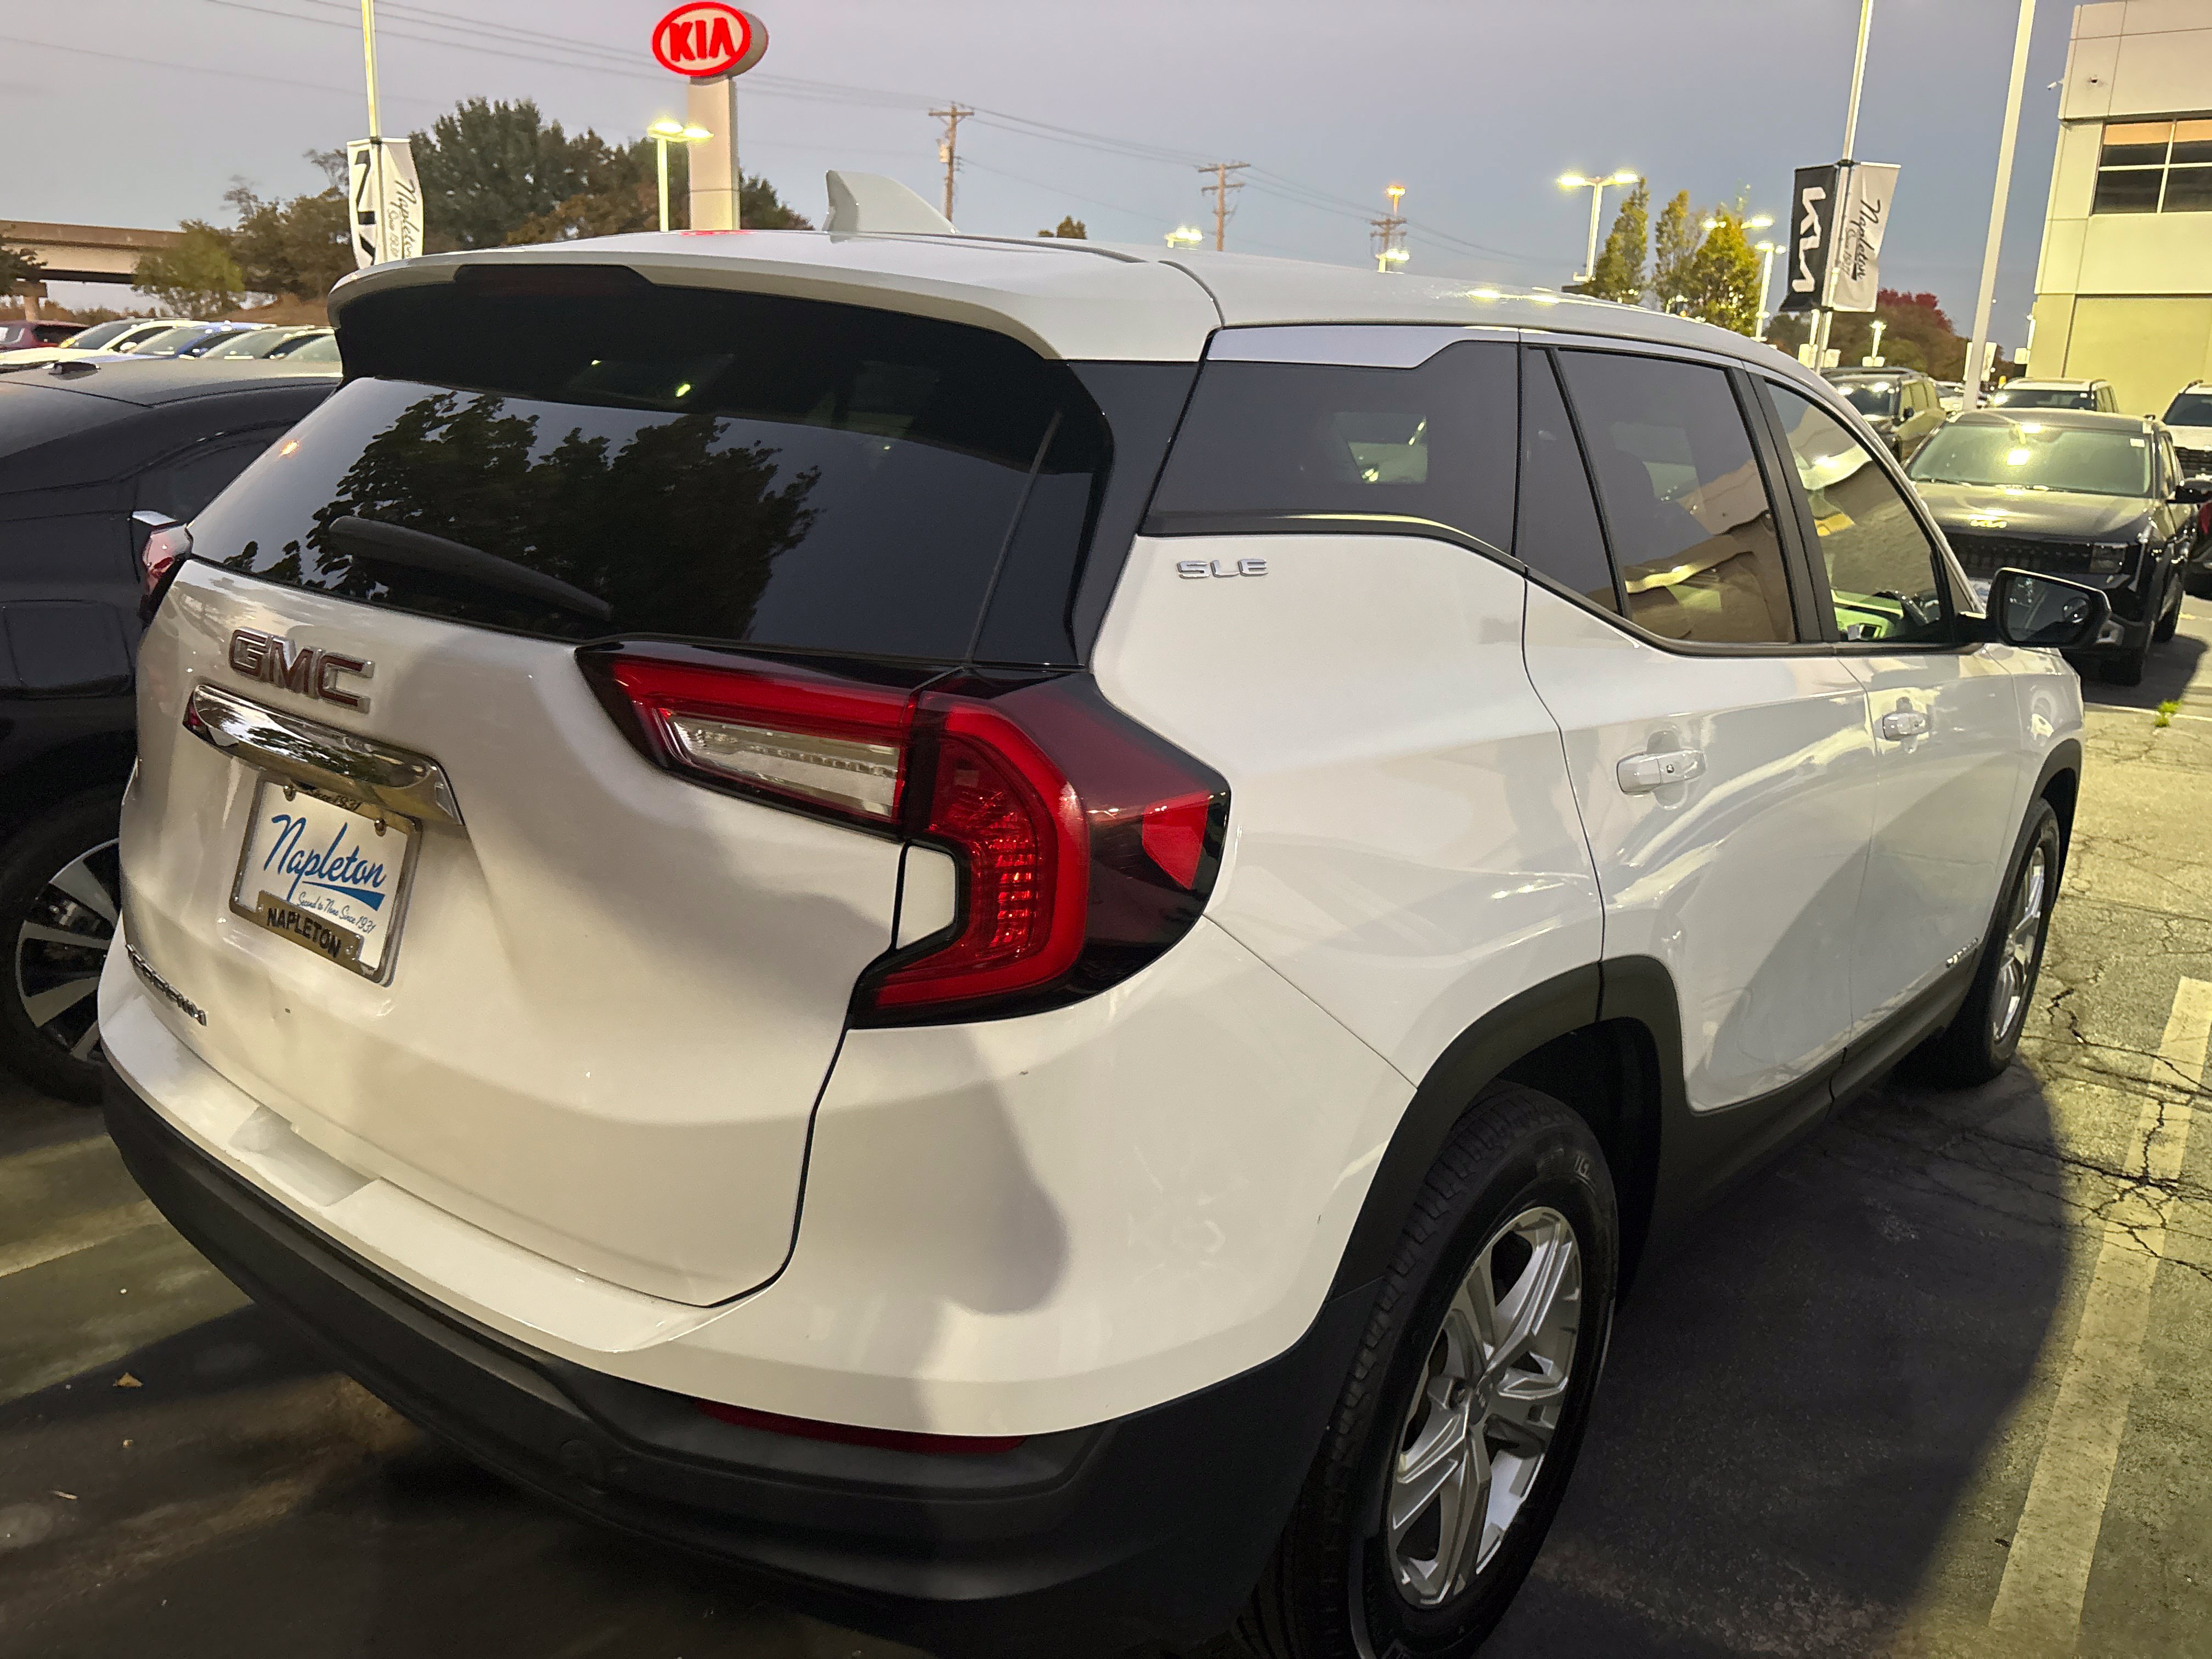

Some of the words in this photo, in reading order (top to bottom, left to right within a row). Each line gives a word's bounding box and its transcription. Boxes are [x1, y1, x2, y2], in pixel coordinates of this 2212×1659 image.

[669, 17, 736, 61] KIA
[1850, 199, 1881, 280] Napleton
[1177, 558, 1268, 579] SLE
[229, 627, 376, 714] GMC
[263, 814, 387, 902] Napleton
[267, 908, 342, 958] NAPLETON
[339, 905, 356, 924] Since
[356, 916, 376, 934] 1931
